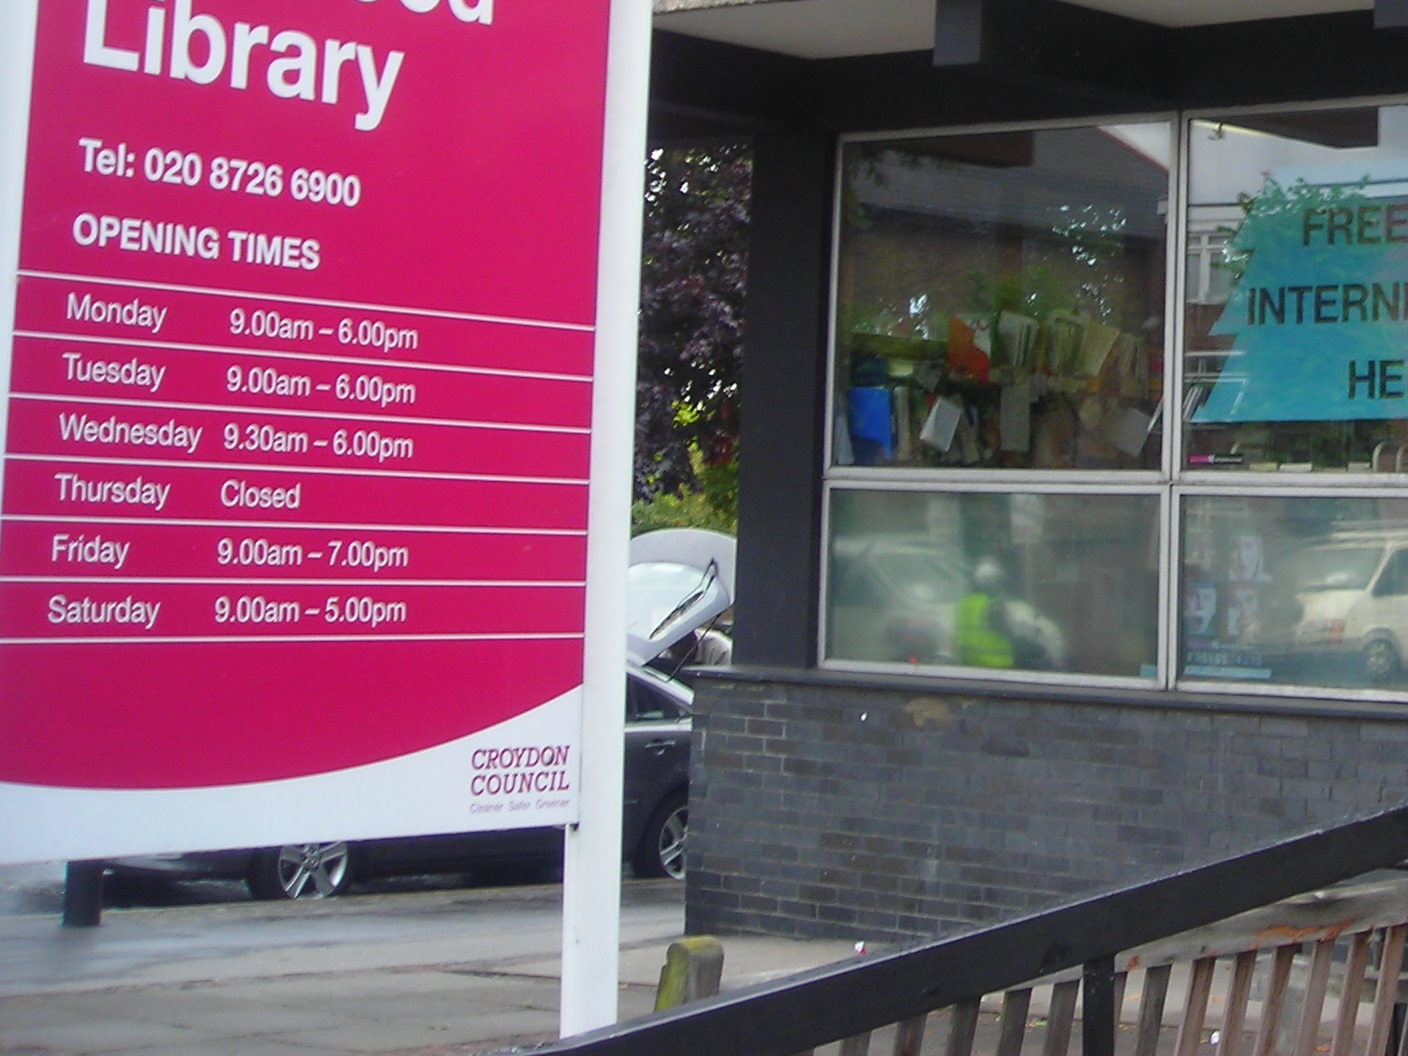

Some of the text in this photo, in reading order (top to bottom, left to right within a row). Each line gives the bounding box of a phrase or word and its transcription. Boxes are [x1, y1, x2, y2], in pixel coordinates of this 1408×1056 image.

[78, 137, 362, 208] Tel: 020 8726 6900
[72, 212, 321, 271] OPENING TIMES
[66, 292, 168, 334] Monday
[229, 307, 314, 341] 9.00am
[338, 318, 419, 352] 6.00pm
[62, 352, 166, 393] Tuesday
[226, 365, 311, 397] 9.00am
[335, 373, 416, 407] 6.00pm
[58, 412, 203, 454] Wednesday
[223, 422, 309, 453] 9.30am
[332, 429, 414, 462] 6.00pm
[54, 473, 301, 511] Thursday Closed
[51, 534, 130, 570] Friday
[217, 538, 303, 566] 9.00am
[327, 540, 409, 572] 7.00pm
[47, 594, 161, 630] Saturday
[214, 596, 300, 623] 9.00am
[324, 596, 407, 628] 5.00pm
[471, 744, 570, 770] CROYDON
[471, 771, 570, 796] COUNCIL
